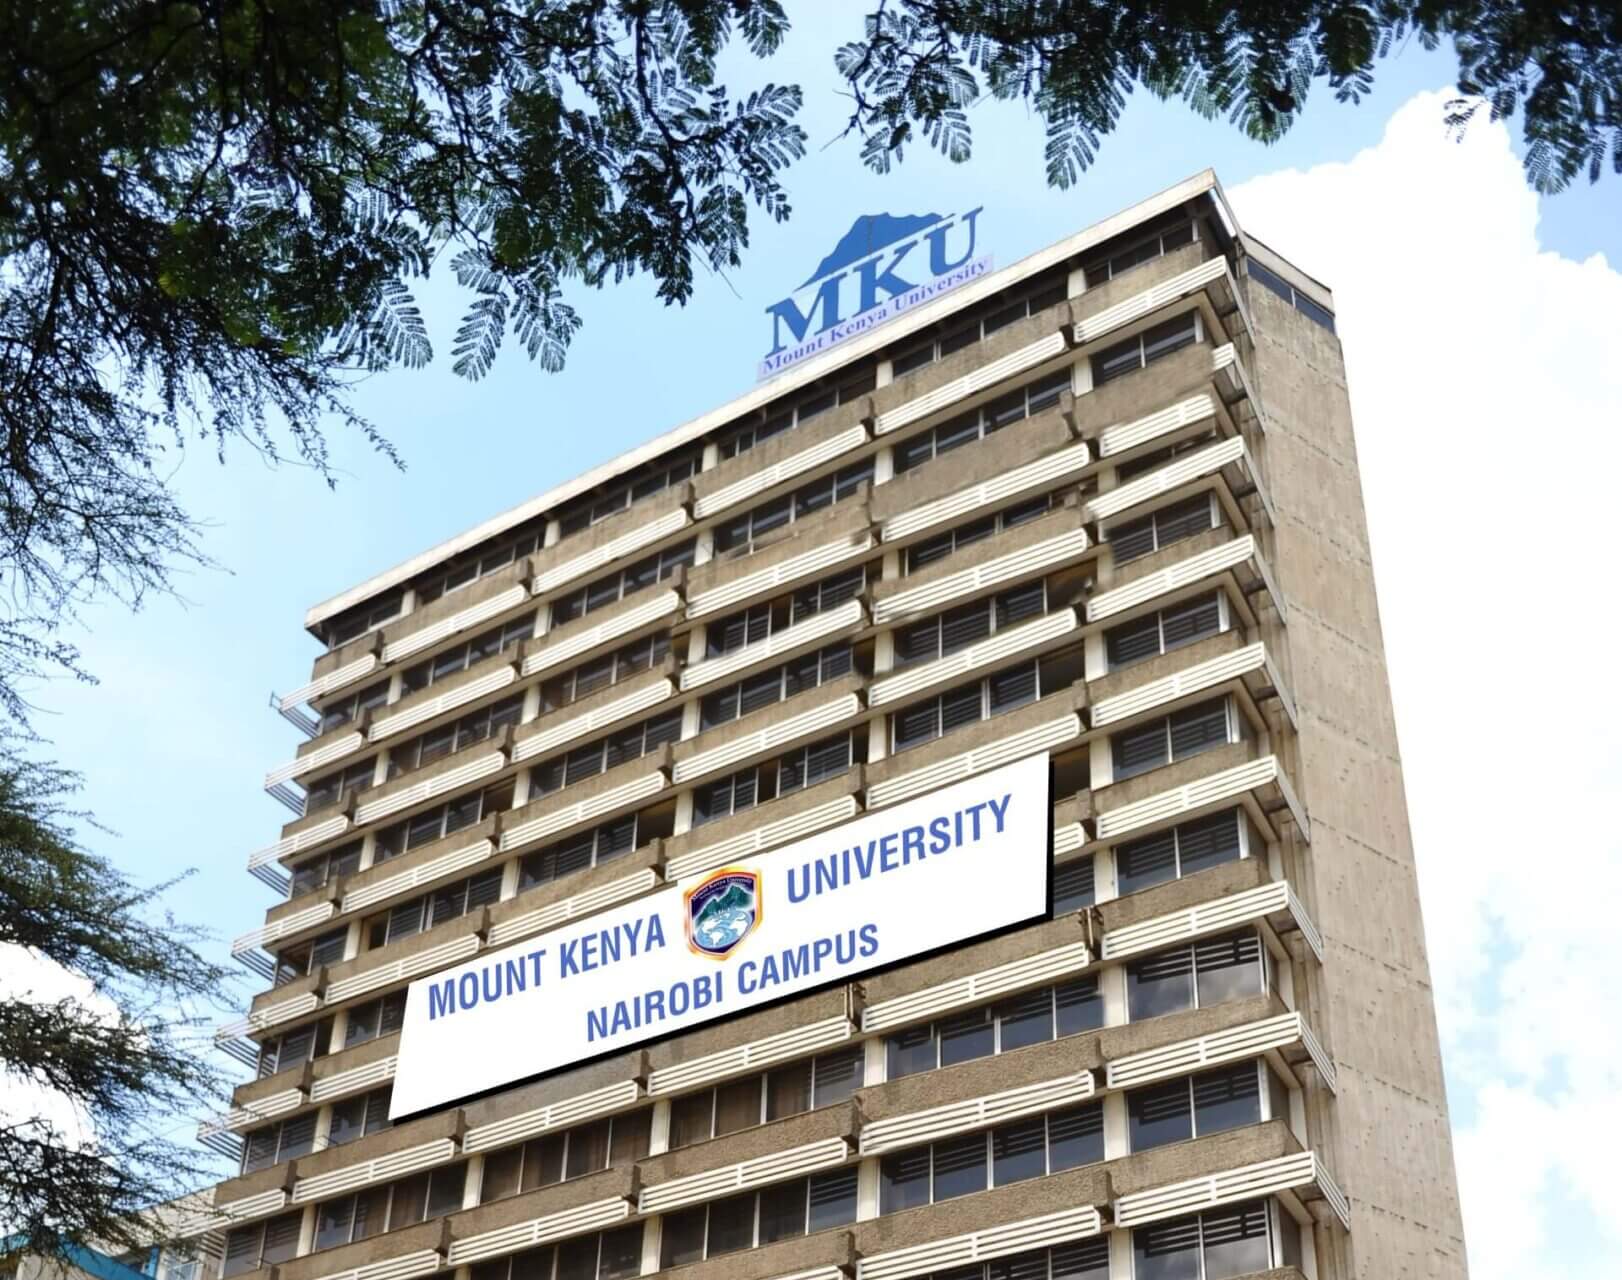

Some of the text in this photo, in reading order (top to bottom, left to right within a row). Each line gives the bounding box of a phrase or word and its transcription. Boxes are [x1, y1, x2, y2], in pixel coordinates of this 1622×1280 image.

[762, 258, 988, 375] Mount Kenya University
[765, 206, 984, 358] MKU
[428, 793, 1013, 1021] MOUNT KENYA UNIVERSITY
[586, 923, 880, 1042] NAIROBI CAMPUS
